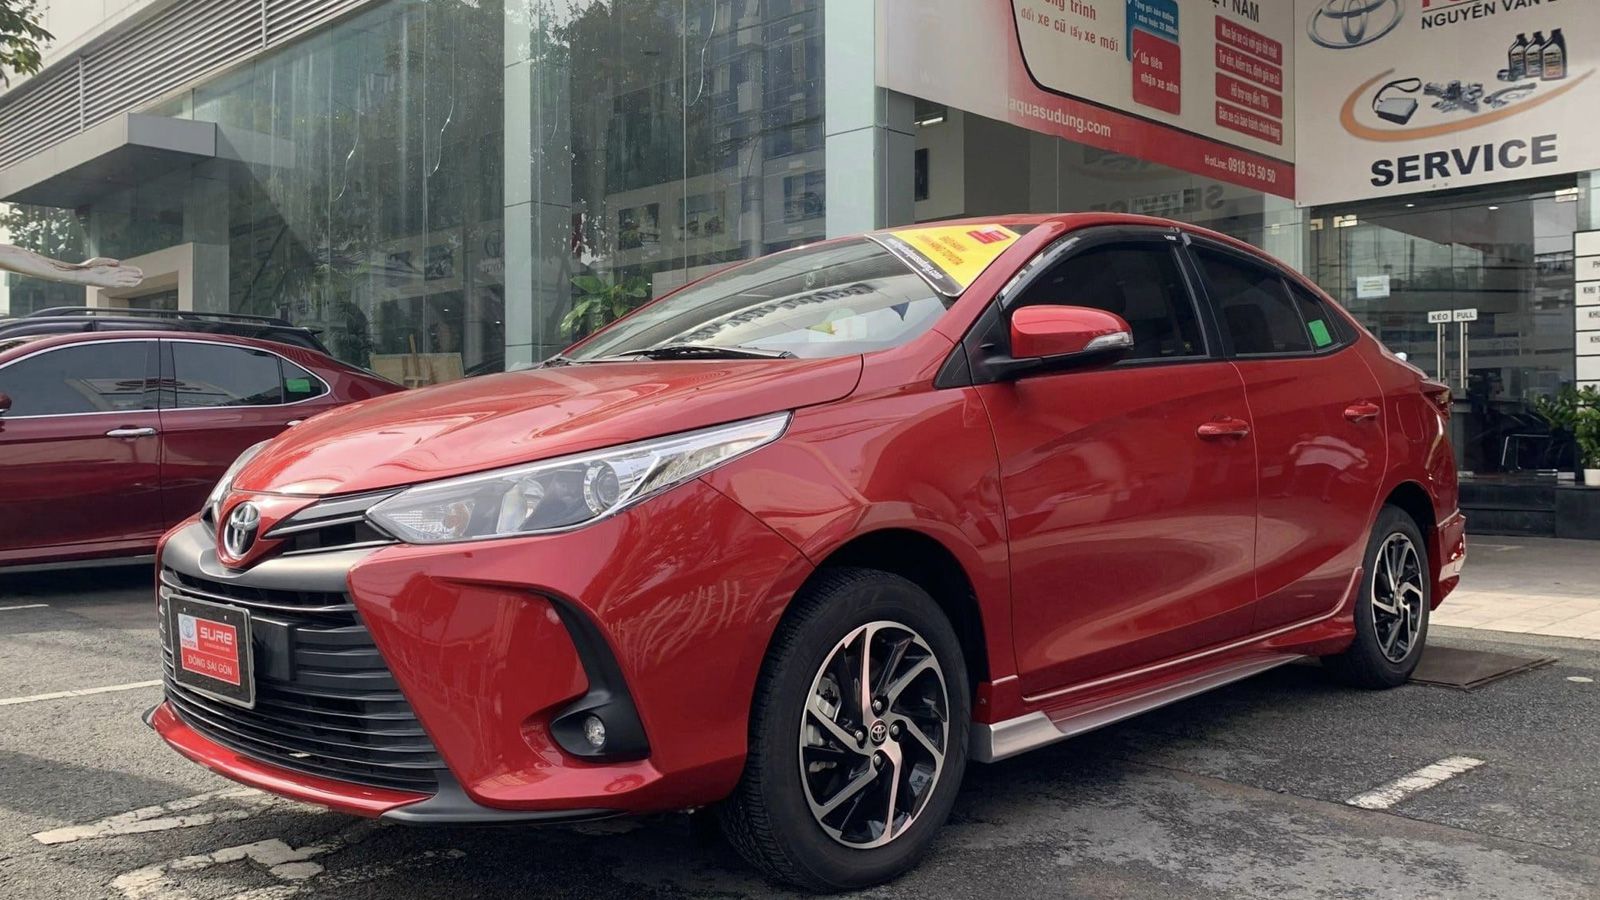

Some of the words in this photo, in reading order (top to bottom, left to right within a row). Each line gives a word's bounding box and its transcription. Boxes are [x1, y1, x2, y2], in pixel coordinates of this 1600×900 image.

[1038, 13, 1049, 27] xe
[1054, 18, 1066, 33] cũ
[1085, 30, 1096, 44] xe
[1100, 37, 1119, 52] mới
[1228, 157, 1246, 175] 0918
[1247, 162, 1256, 178] 33
[1257, 166, 1266, 181] 50
[1267, 168, 1276, 184] 50
[1370, 134, 1558, 187] SERVICE
[1456, 311, 1475, 319] PULL
